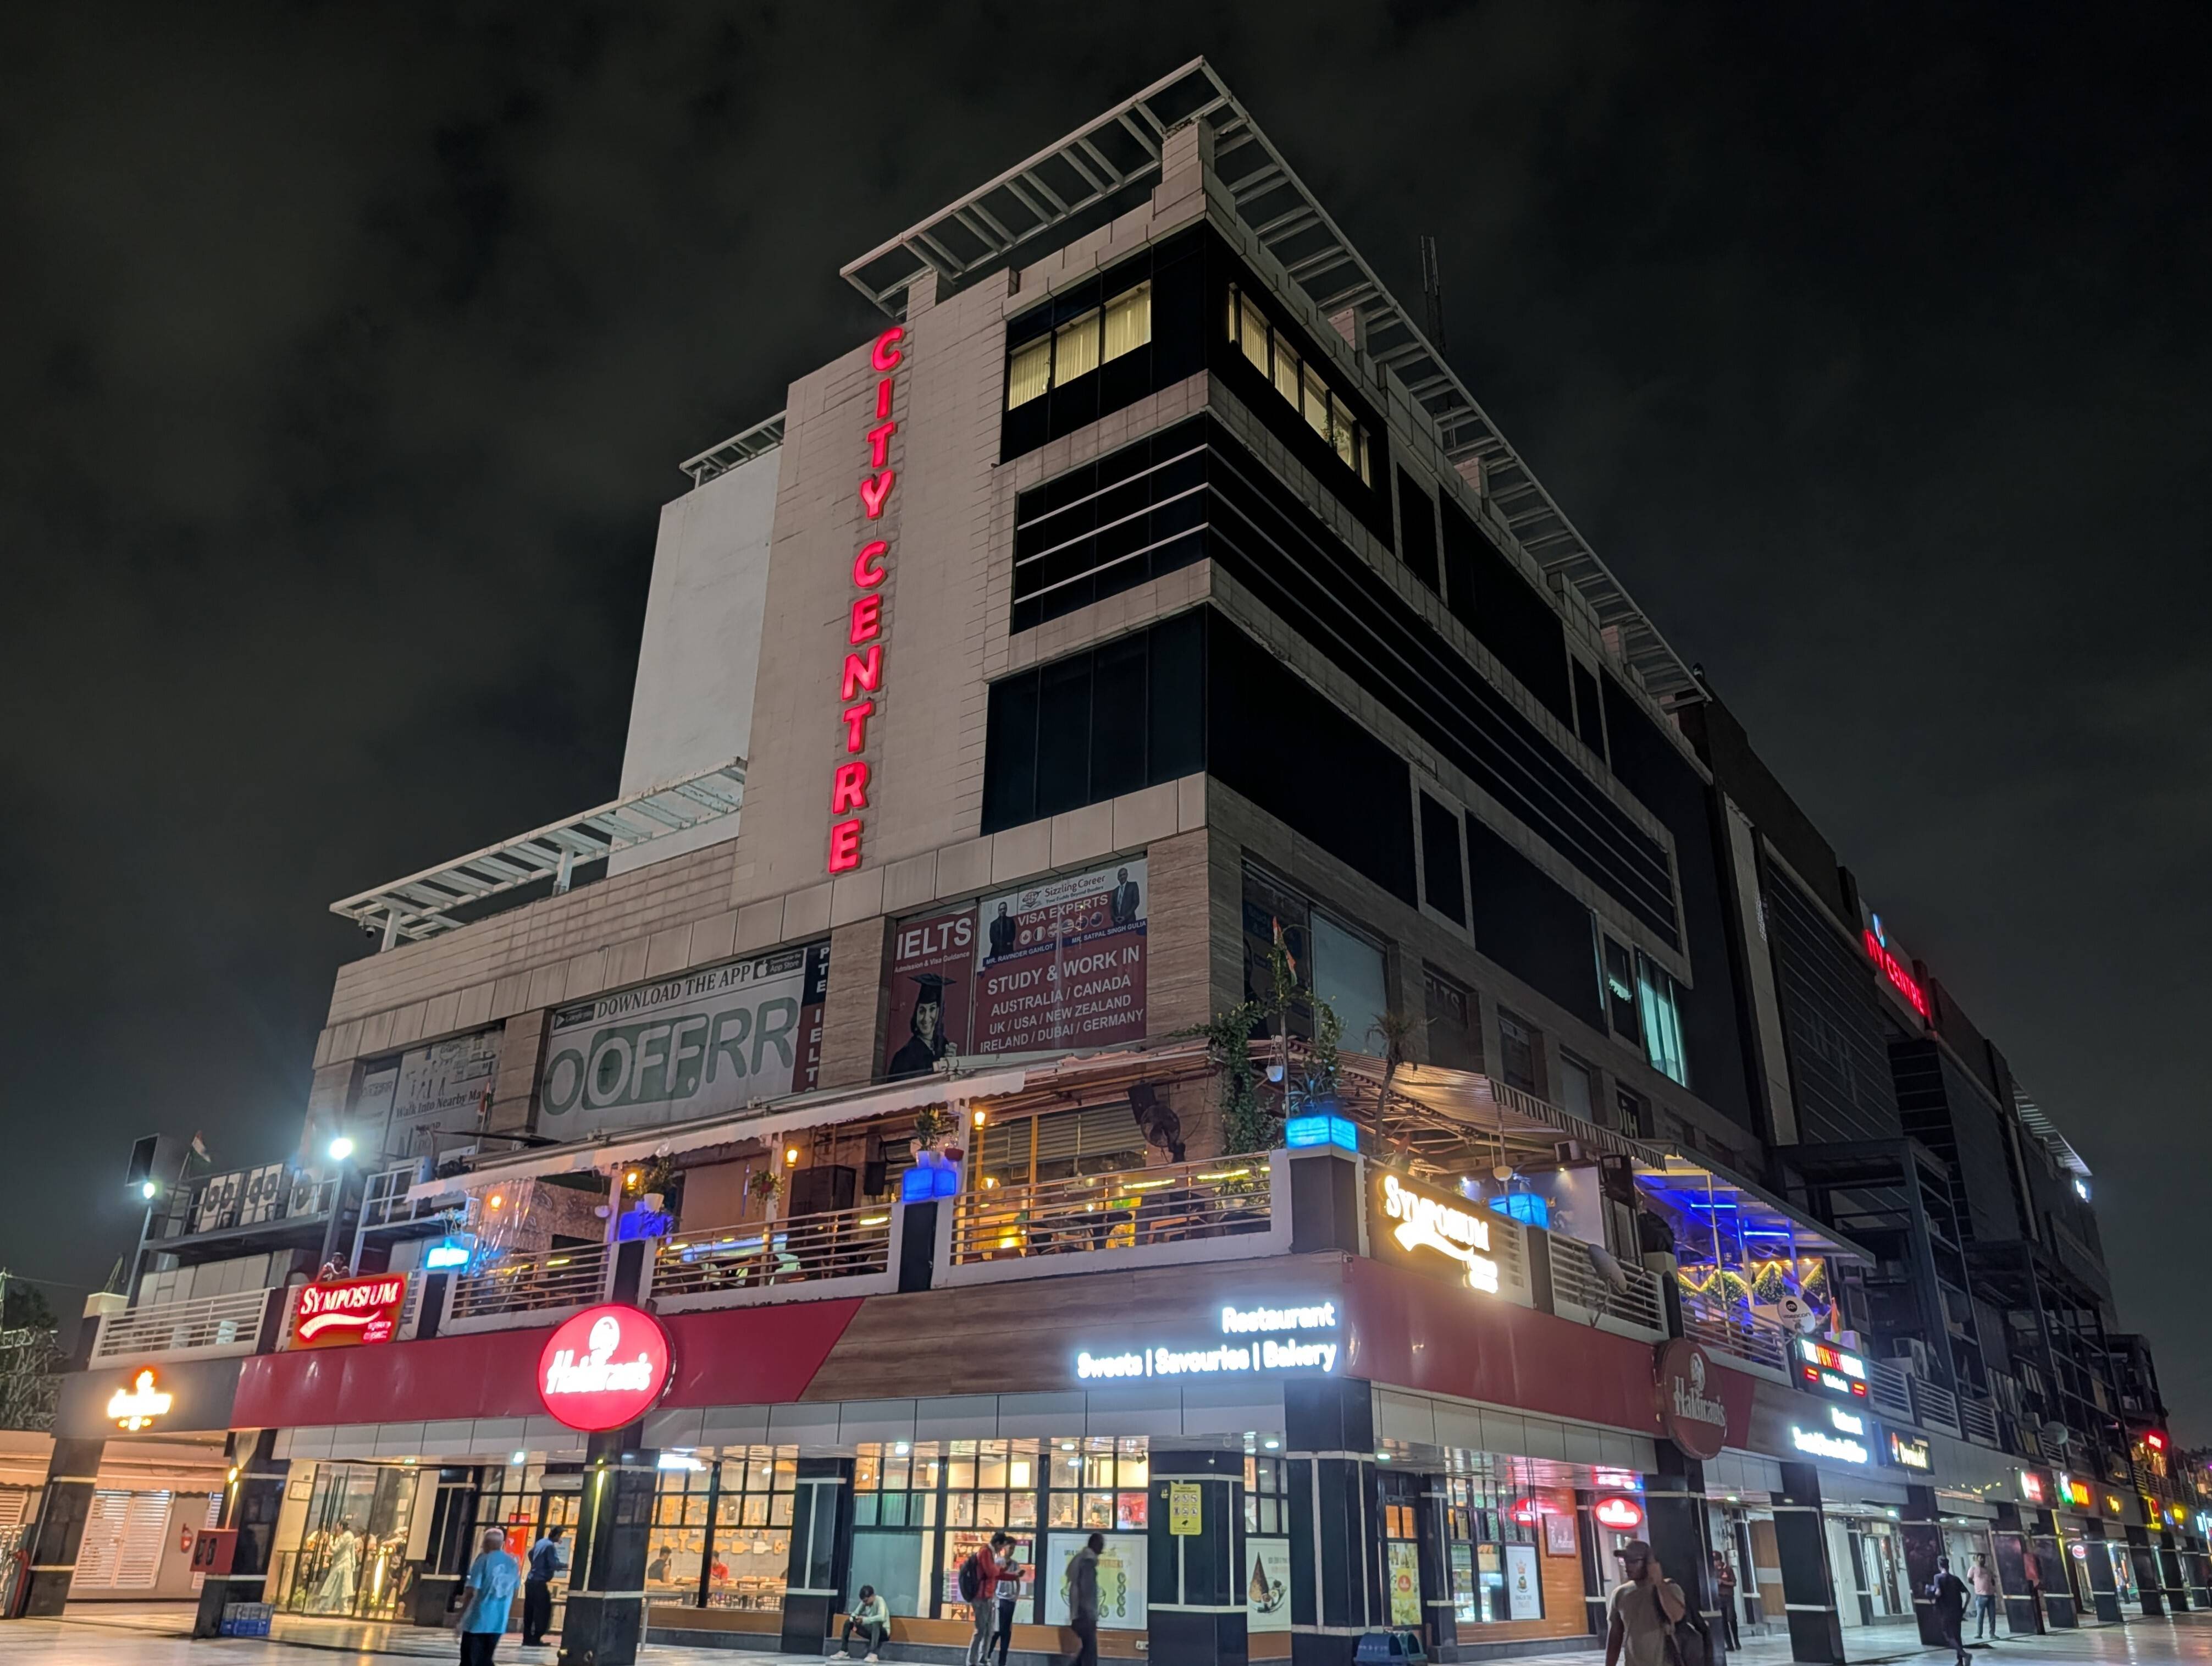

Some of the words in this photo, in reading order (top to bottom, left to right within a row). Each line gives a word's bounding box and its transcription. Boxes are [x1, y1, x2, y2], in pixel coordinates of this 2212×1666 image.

[861, 327, 904, 519] CITY
[828, 540, 887, 874] CENTRE
[1018, 912, 1046, 927] VISA
[1049, 894, 1108, 918] EXPERTS
[897, 917, 972, 961] IELTS
[1083, 931, 1105, 942] SATPAL
[1107, 925, 1126, 936] SINGH
[1127, 920, 1146, 931] GULIA
[770, 964, 782, 973] App
[784, 960, 799, 969] Store
[816, 947, 830, 994] PTE
[894, 962, 923, 973] Admission
[930, 956, 942, 965] Visa
[943, 951, 970, 962] Guidance
[987, 967, 1043, 995] STUDY
[1046, 965, 1058, 981] &
[1063, 950, 1118, 978] WORK
[1122, 945, 1140, 964] IN
[998, 949, 1028, 962] RAVINDER
[1028, 943, 1054, 955] GAHLOT
[598, 983, 681, 1019] DOWNLOAD
[685, 973, 716, 996] THE
[718, 965, 751, 988] APP
[991, 989, 1064, 1017] AUSTRALIA
[1066, 987, 1071, 1000] /
[1074, 974, 1131, 998] CANADA
[980, 1033, 1028, 1053] IRELAND
[1031, 1031, 1036, 1043] /
[1037, 1023, 1074, 1041] DUBAI
[1076, 1022, 1081, 1034] /
[1083, 1008, 1144, 1032] GERMANY
[989, 1021, 1005, 1035] UK
[1007, 1018, 1012, 1031] /
[1014, 1017, 1037, 1030] USA
[1039, 1013, 1043, 1027] /
[1046, 1007, 1072, 1023] NEW
[1075, 994, 1131, 1017] ZEALAND
[396, 1101, 417, 1118] Walk
[418, 1100, 435, 1113] Into
[436, 1093, 467, 1109] Nearby
[300, 1282, 401, 1315] SYMPOSIUM
[1222, 1302, 1336, 1333] Restaurant
[1077, 1352, 1143, 1378] Sweets
[1155, 1344, 1249, 1375] Savouries
[1263, 1339, 1337, 1372] Bakery
